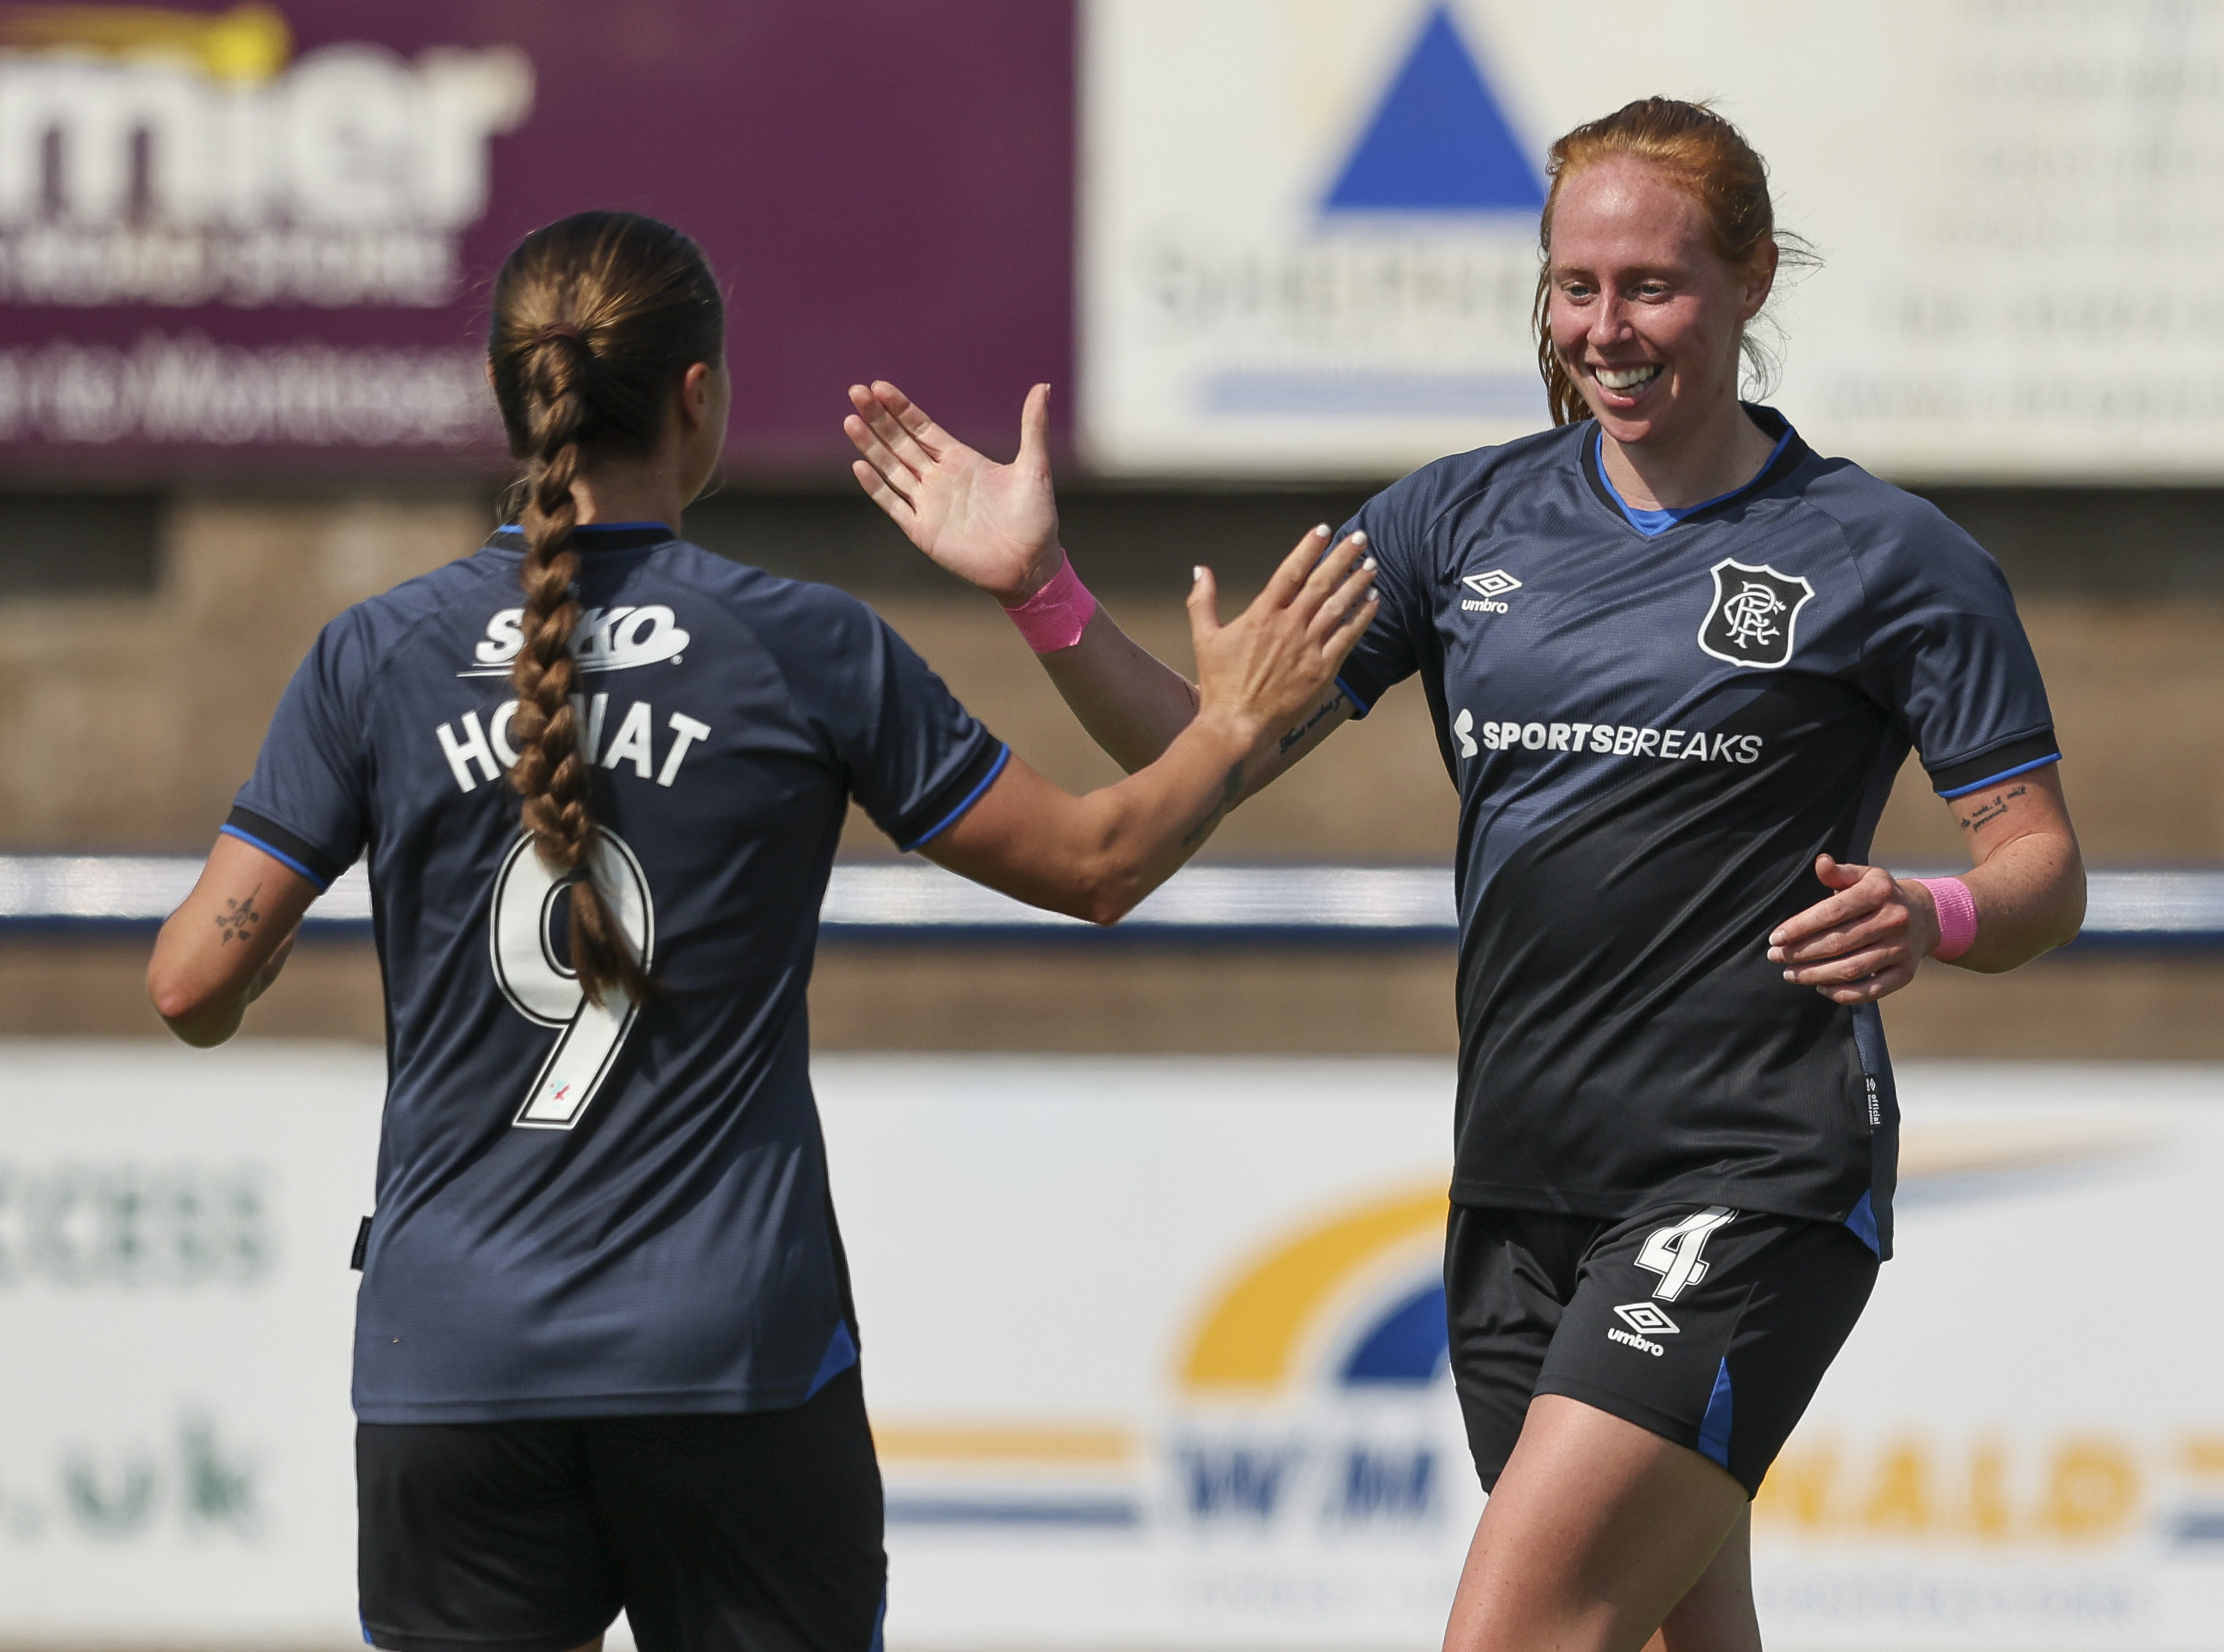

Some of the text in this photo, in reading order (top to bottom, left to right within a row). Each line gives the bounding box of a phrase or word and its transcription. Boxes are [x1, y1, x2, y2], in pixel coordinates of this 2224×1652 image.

[1461, 598, 1509, 615] umbro
[474, 603, 690, 664] SKO
[1482, 720, 1763, 765] SPORTSBREAKS
[489, 822, 655, 1130] 9
[1871, 1094, 1881, 1125] official
[1633, 1205, 1741, 1302] 4
[1606, 1327, 1665, 1357] umbro
